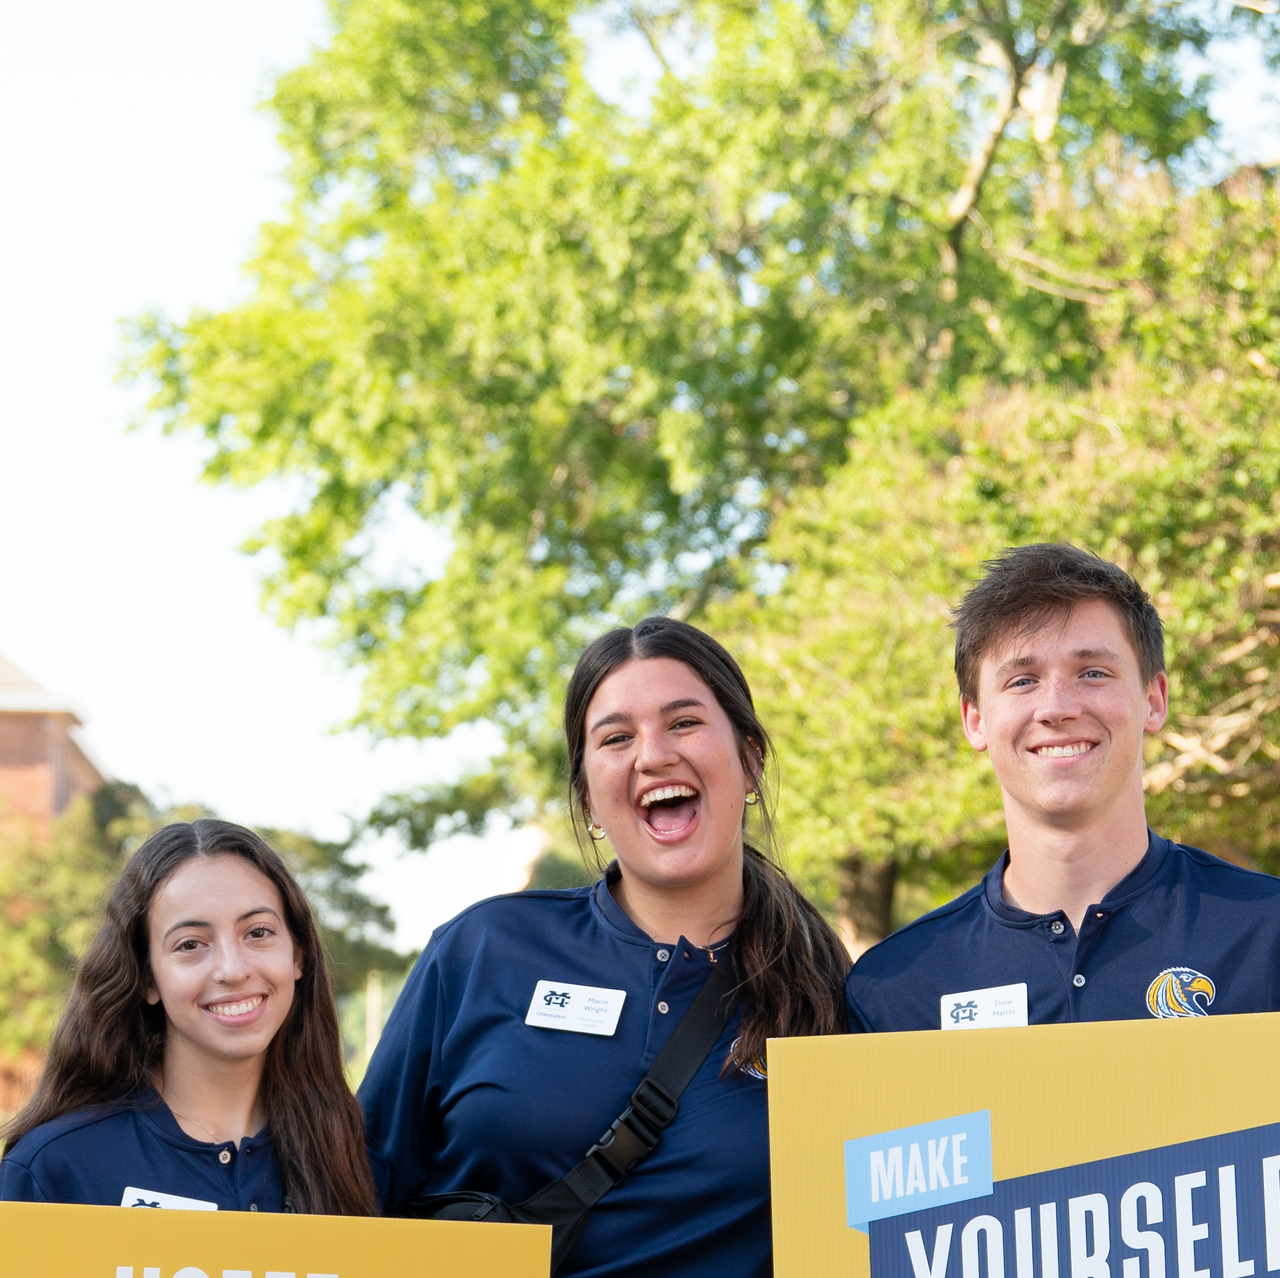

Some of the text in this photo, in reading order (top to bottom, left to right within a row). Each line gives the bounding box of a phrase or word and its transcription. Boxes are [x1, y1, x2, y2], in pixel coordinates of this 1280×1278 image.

[587, 997, 609, 1005] Macie
[994, 999, 1013, 1007] Drew
[584, 1005, 608, 1014] Wright
[992, 1008, 1015, 1017] Martin
[536, 1011, 567, 1020] Orientation
[870, 1133, 969, 1203] MAKE
